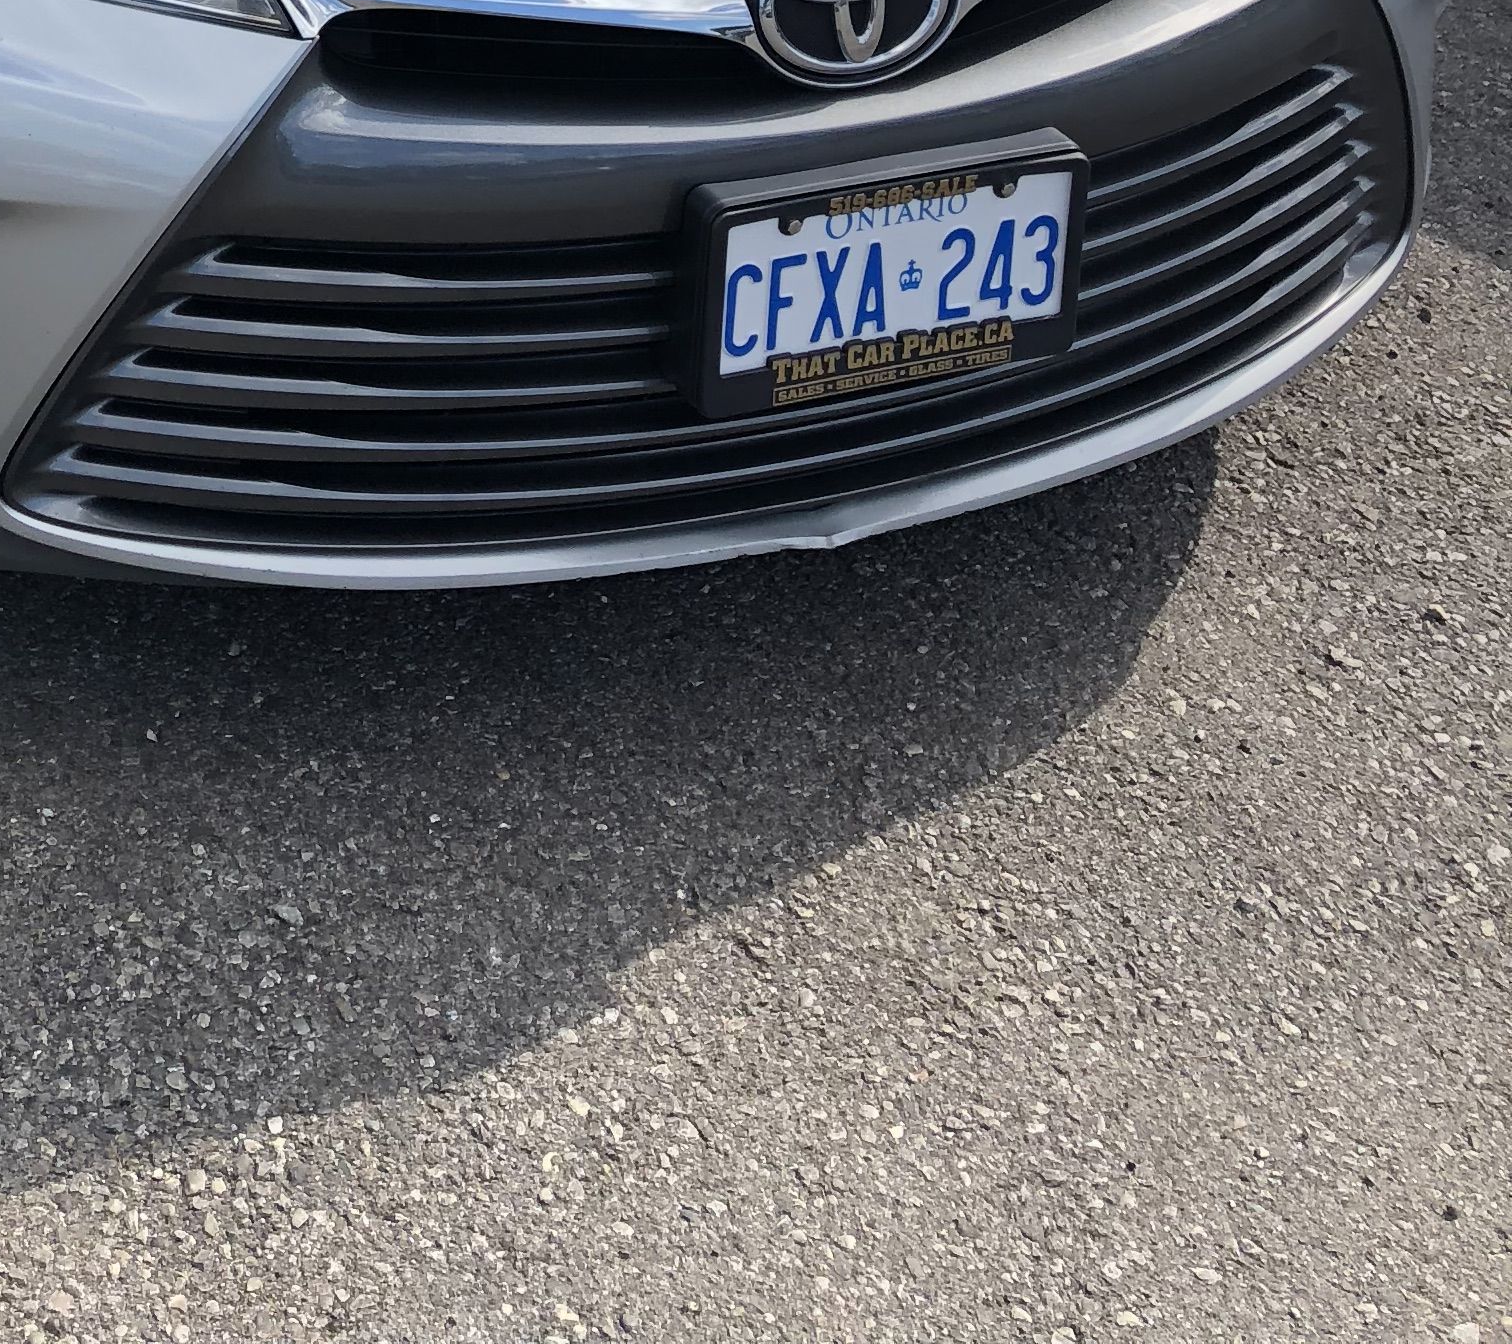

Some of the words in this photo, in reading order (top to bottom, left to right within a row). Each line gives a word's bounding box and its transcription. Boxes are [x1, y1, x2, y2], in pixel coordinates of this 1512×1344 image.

[724, 241, 887, 357] CFXA
[936, 214, 1061, 321] 243
[772, 350, 841, 384] THAT
[847, 340, 896, 370] CAR
[901, 320, 1015, 360] PLACE.CA
[778, 383, 825, 402] SALES
[835, 369, 897, 390] SERVICE
[908, 358, 954, 377] GLASS
[965, 349, 1009, 367] TIRES
